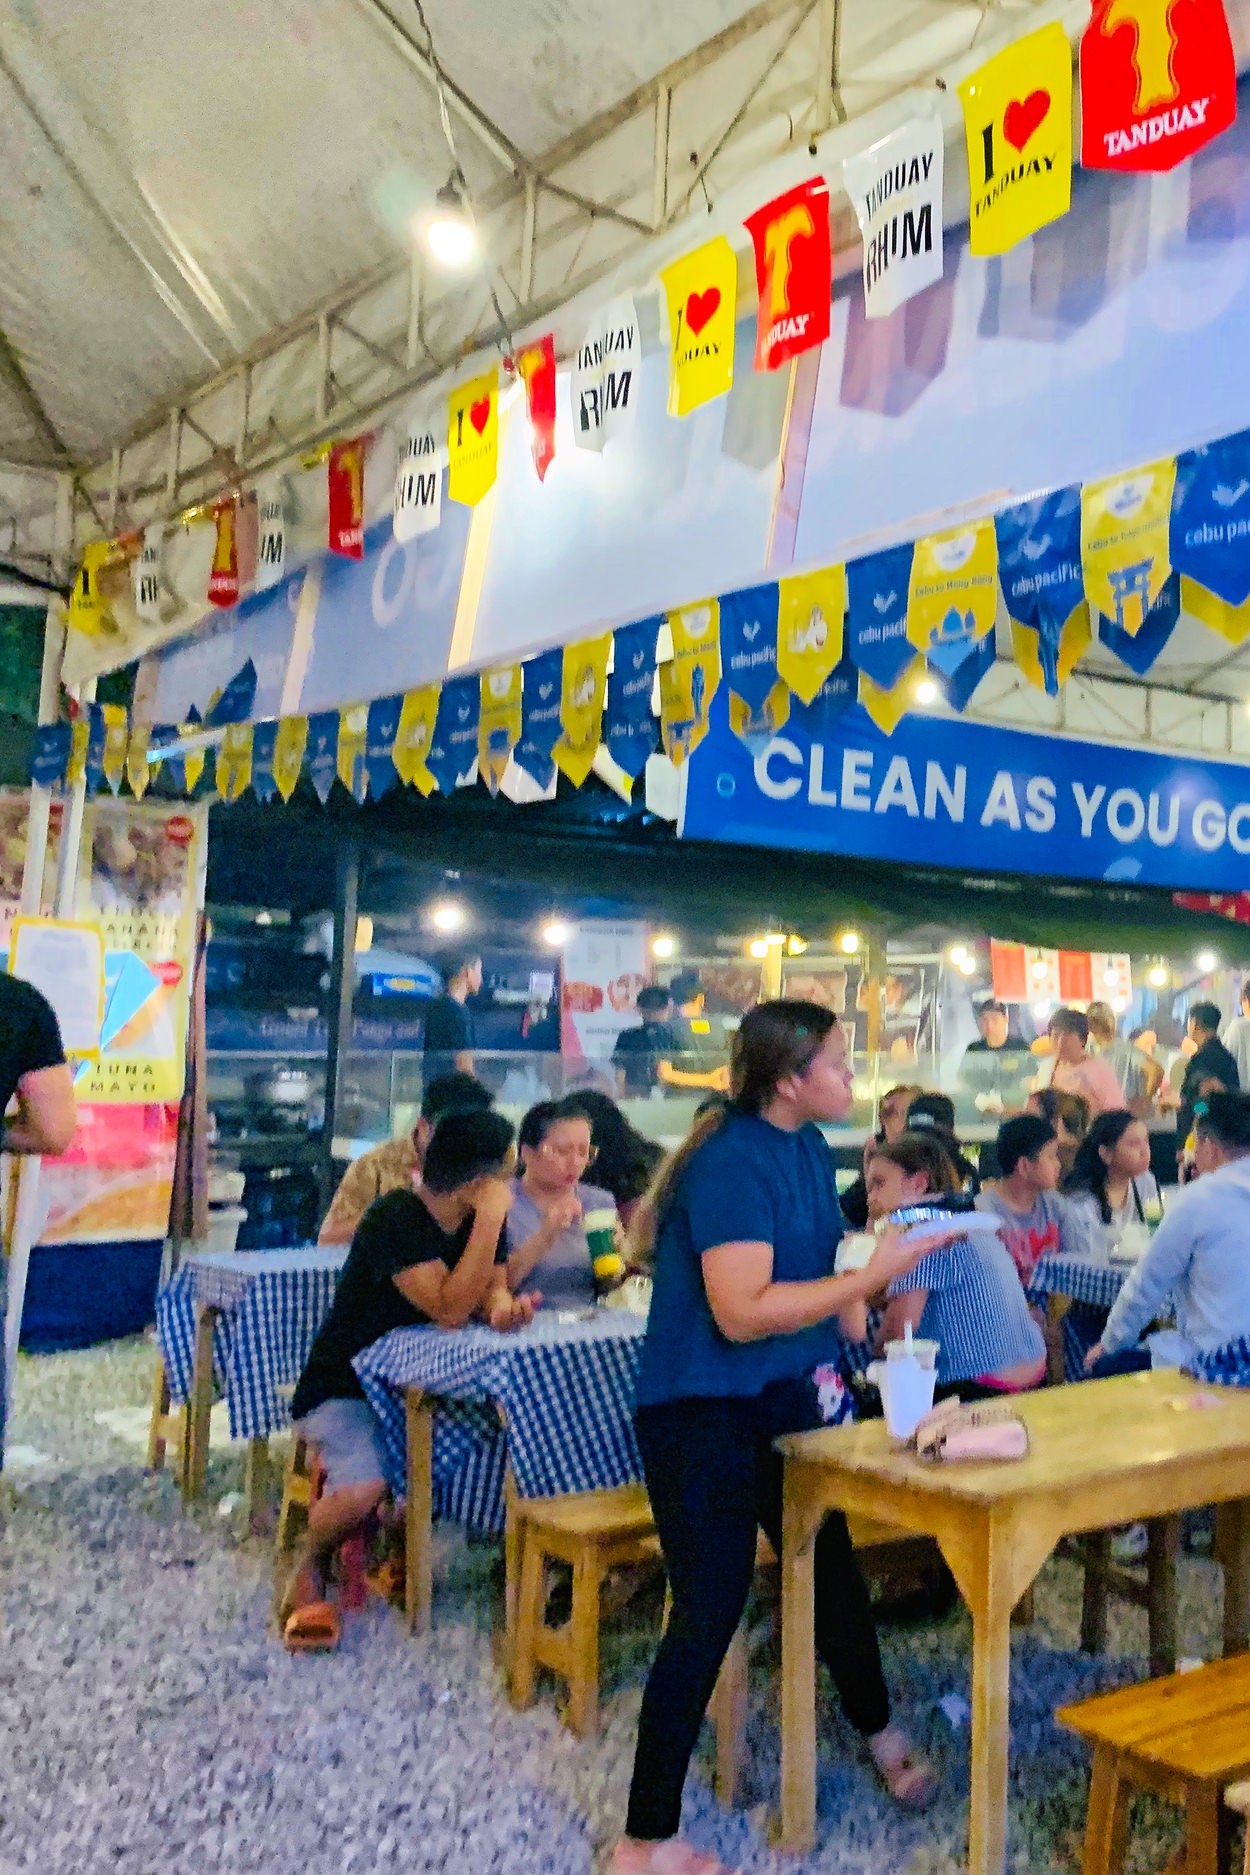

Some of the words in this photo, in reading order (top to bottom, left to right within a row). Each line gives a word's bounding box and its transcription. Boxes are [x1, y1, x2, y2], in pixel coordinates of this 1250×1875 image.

[1104, 97, 1209, 157] TANDUAY
[865, 151, 934, 222] TANDUAY
[975, 152, 1056, 219] TANDUAY
[1184, 522, 1224, 548] cebu
[753, 737, 967, 823] CLEAN
[980, 770, 1057, 833] AS
[1072, 781, 1180, 847] YOU
